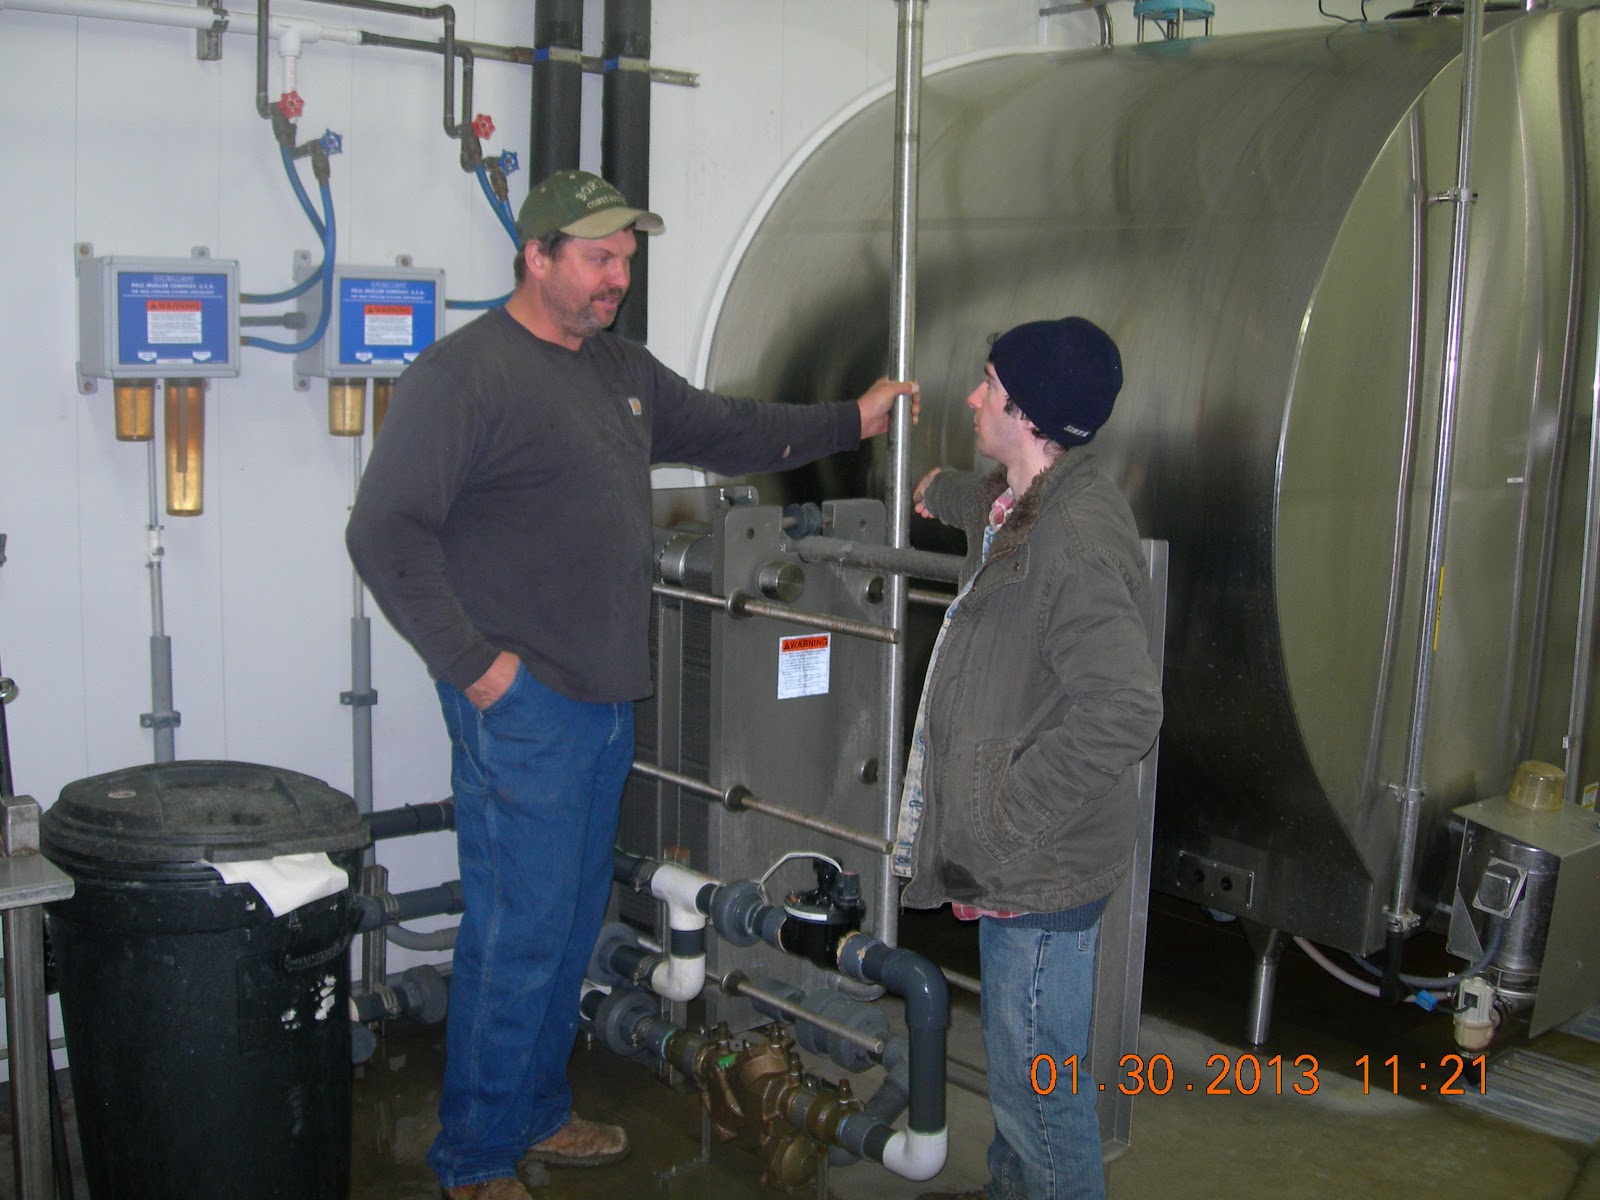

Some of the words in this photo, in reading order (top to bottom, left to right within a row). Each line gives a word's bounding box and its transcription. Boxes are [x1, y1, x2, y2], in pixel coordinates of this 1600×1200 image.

[159, 300, 199, 310] WARNING
[375, 306, 412, 316] WARNING
[789, 637, 828, 648] WARNING
